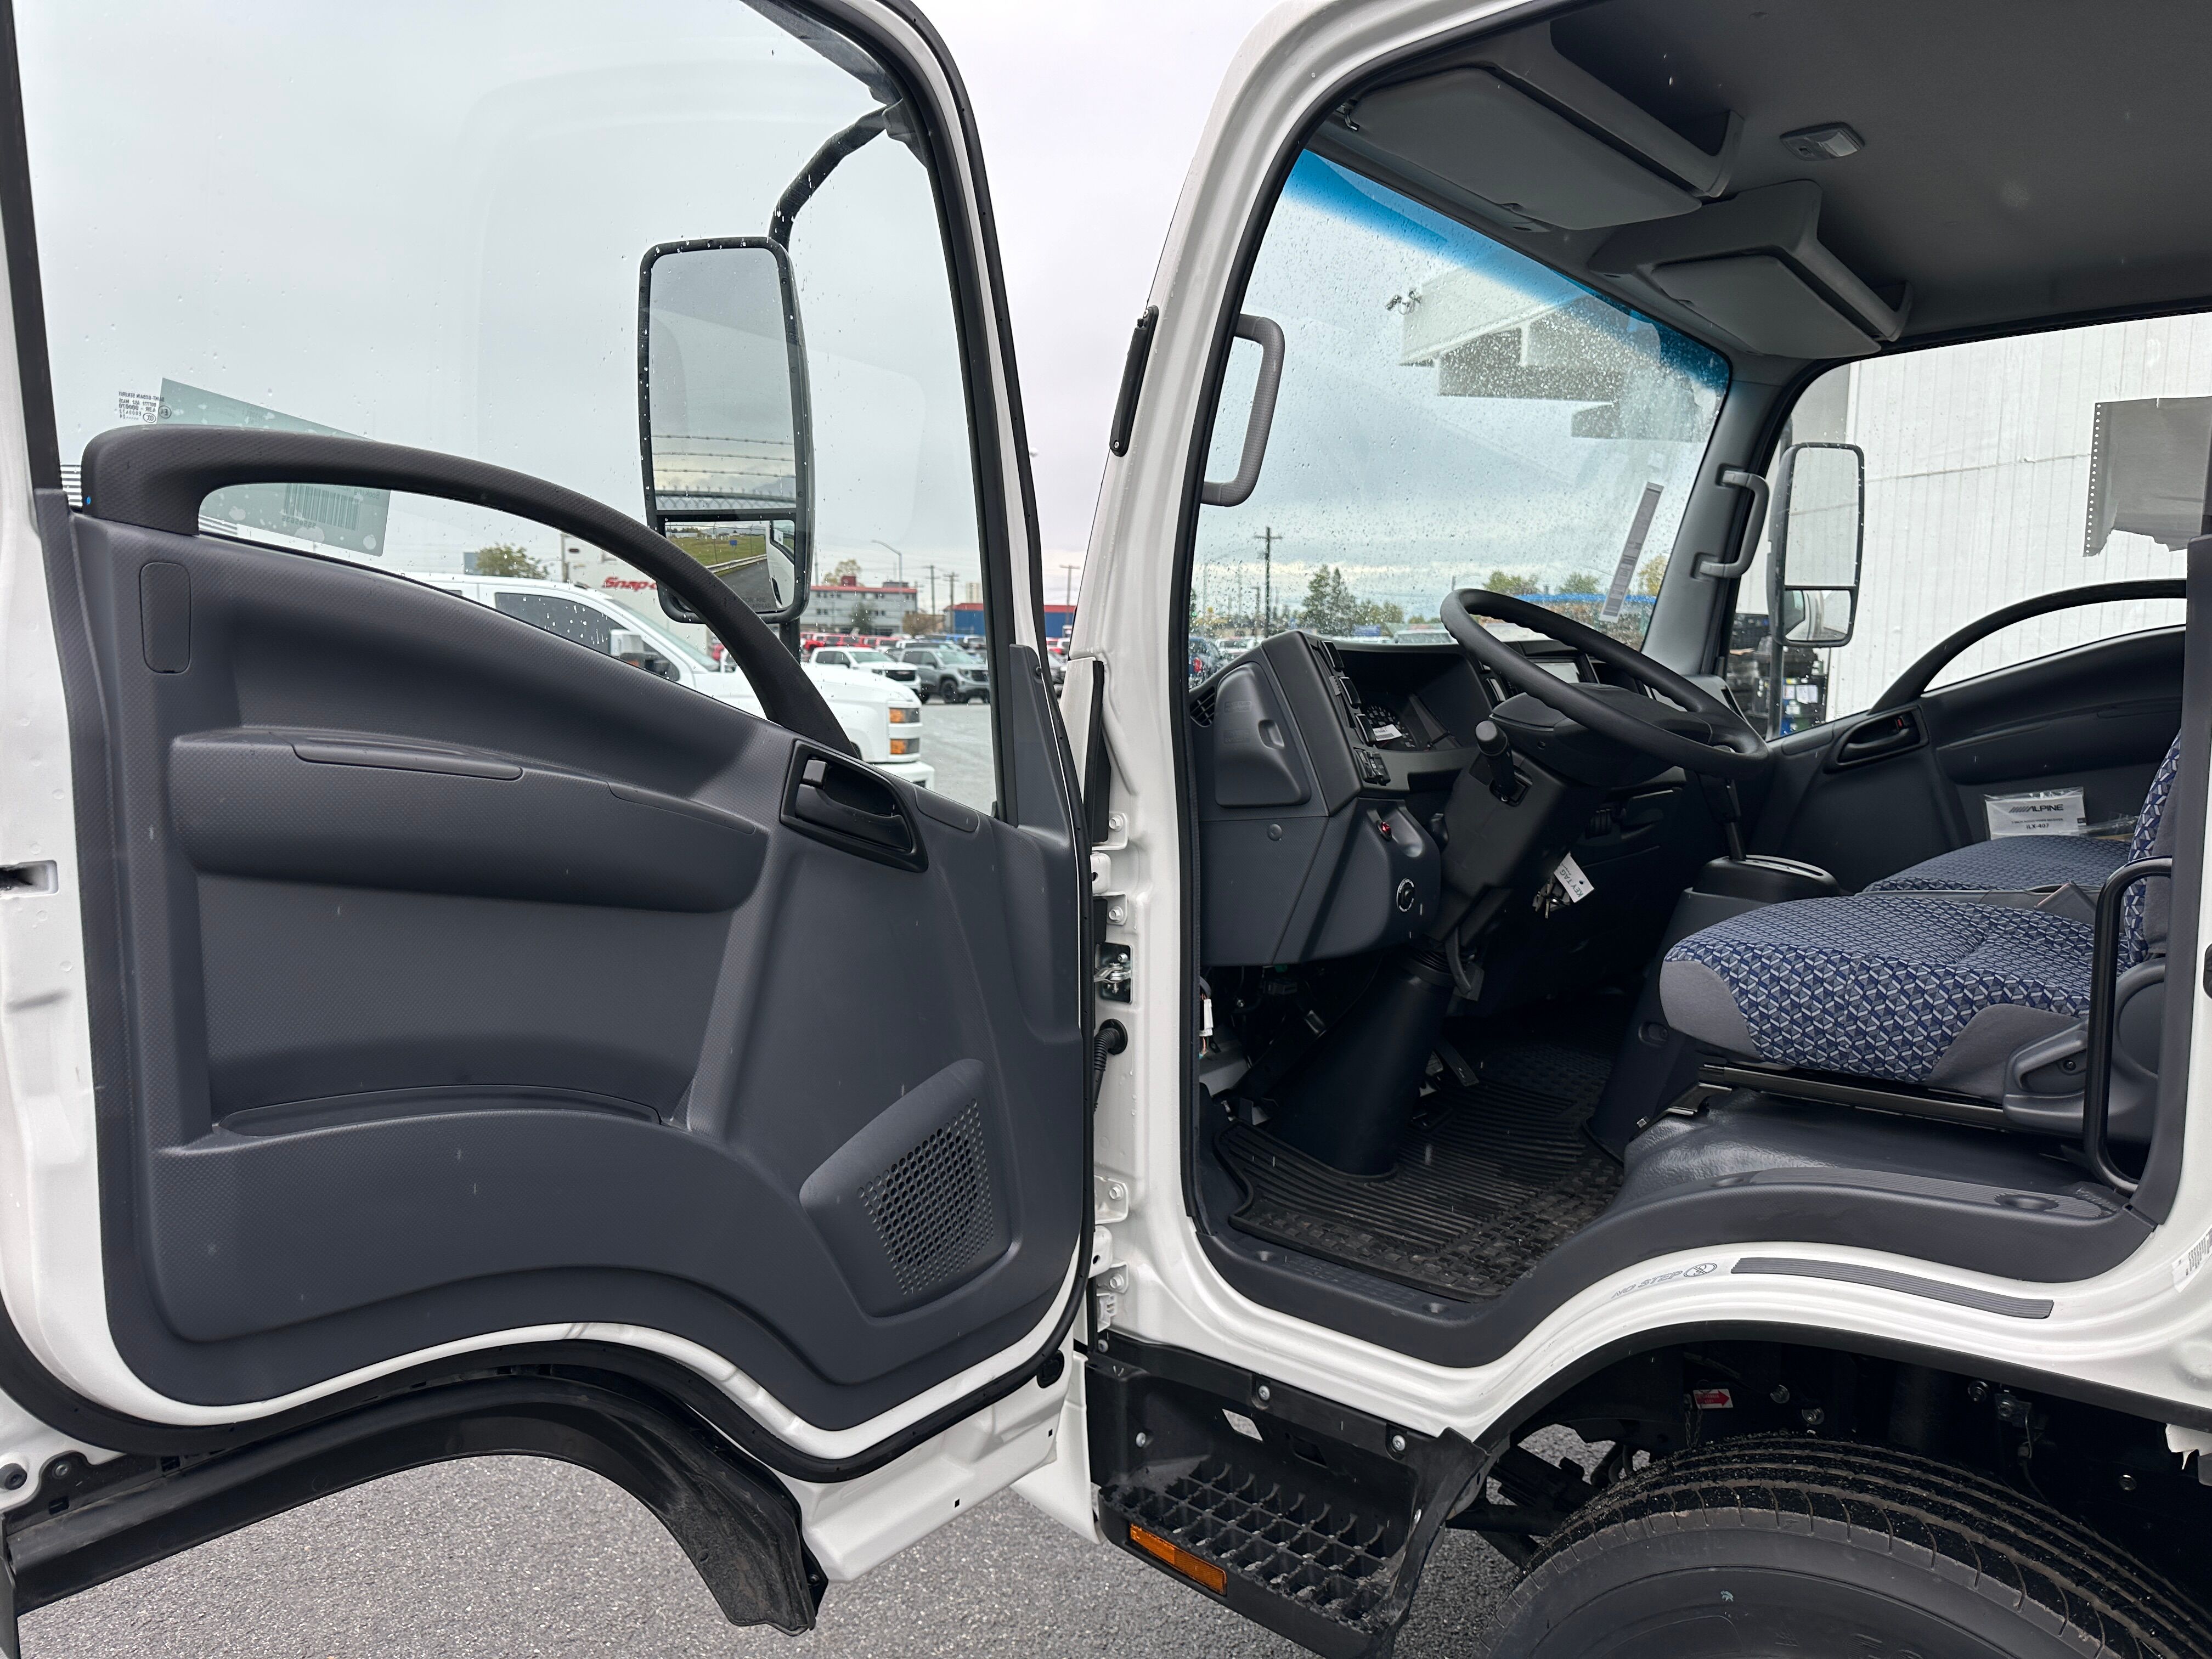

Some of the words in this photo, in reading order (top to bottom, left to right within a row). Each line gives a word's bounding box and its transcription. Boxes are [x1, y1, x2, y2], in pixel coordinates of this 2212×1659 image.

[2024, 804, 2064, 812] ALPINE
[1559, 869, 1572, 884] TAG
[1571, 884, 1584, 898] KEY
[1610, 1284, 1637, 1299] NO
[1638, 1270, 1683, 1288] STEP
